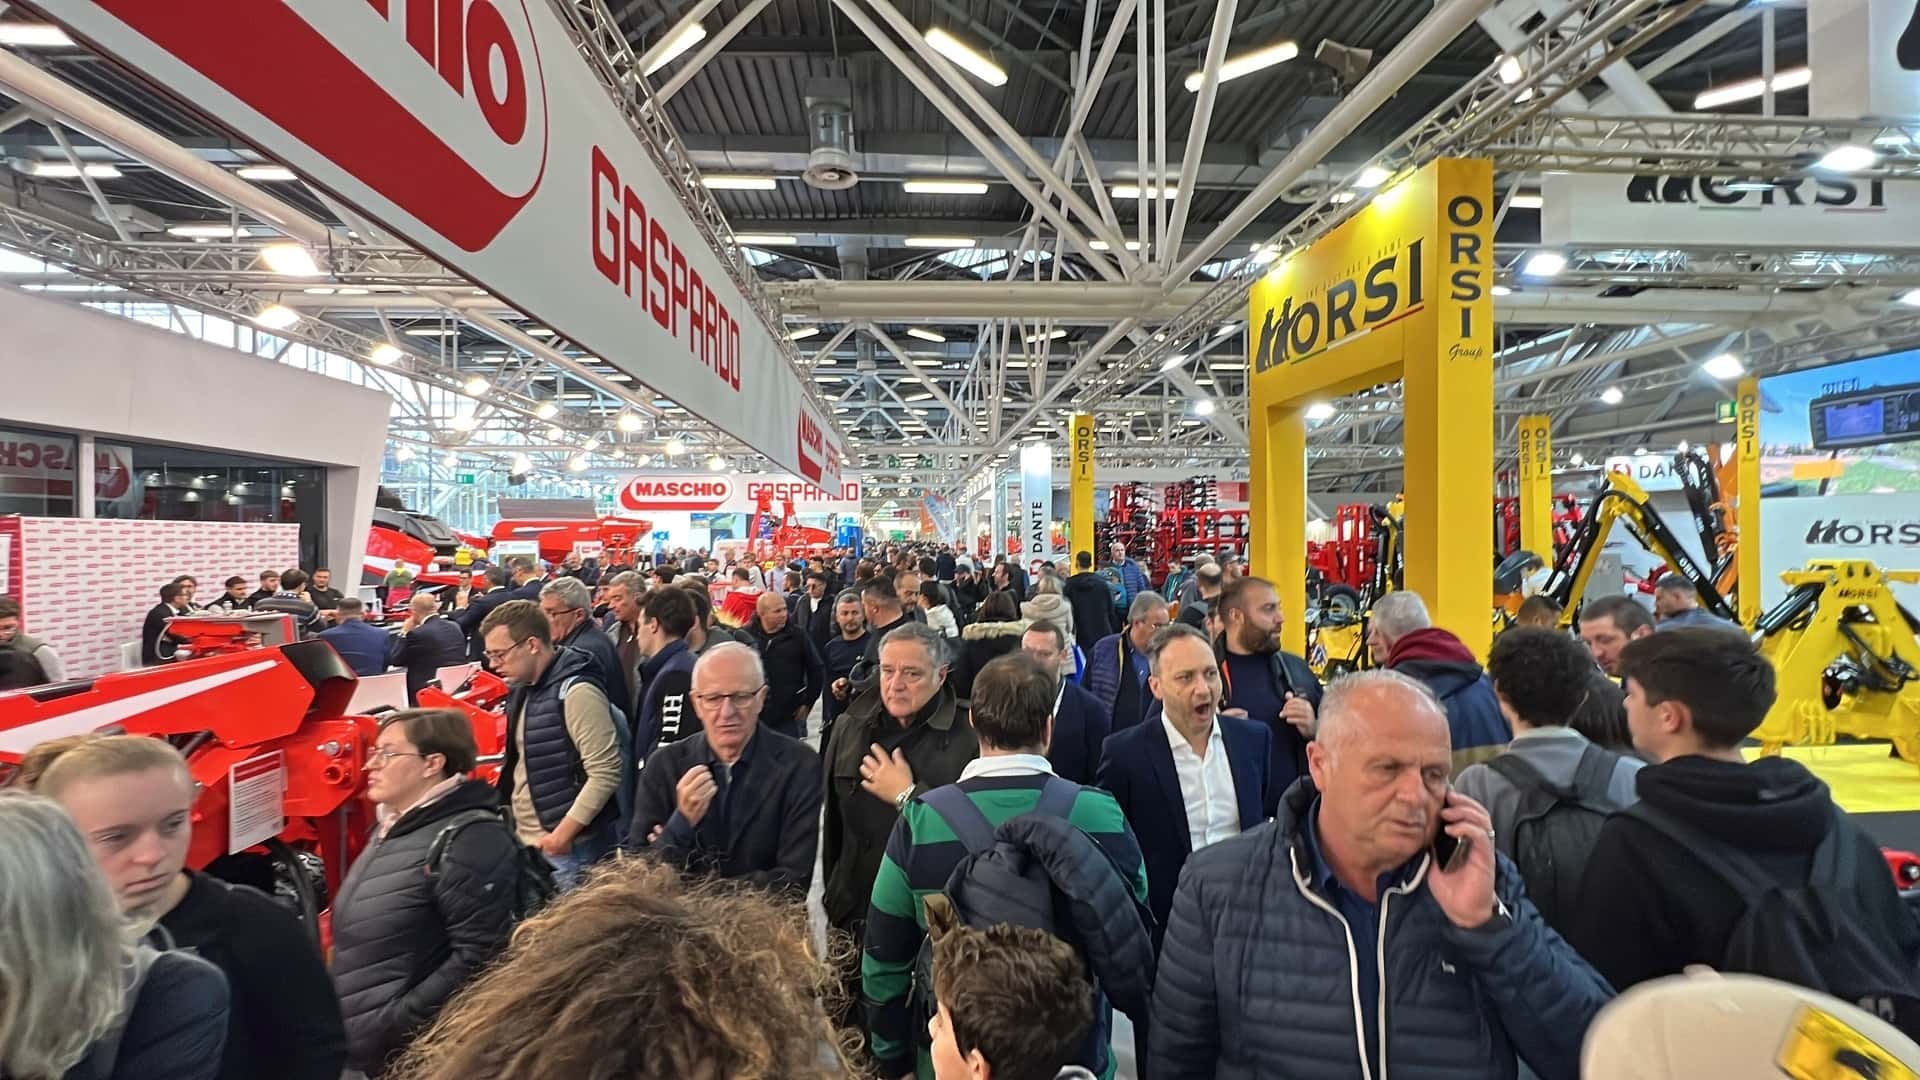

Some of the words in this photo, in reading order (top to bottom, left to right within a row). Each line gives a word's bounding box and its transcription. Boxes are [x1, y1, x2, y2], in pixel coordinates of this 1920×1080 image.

[592, 145, 740, 392] GASPARDO
[1448, 196, 1483, 338] ORSI
[1078, 426, 1090, 475] ORSI
[1742, 394, 1755, 454] ORSI
[636, 482, 727, 497] MASCHIO
[1032, 501, 1043, 553] DANTE
